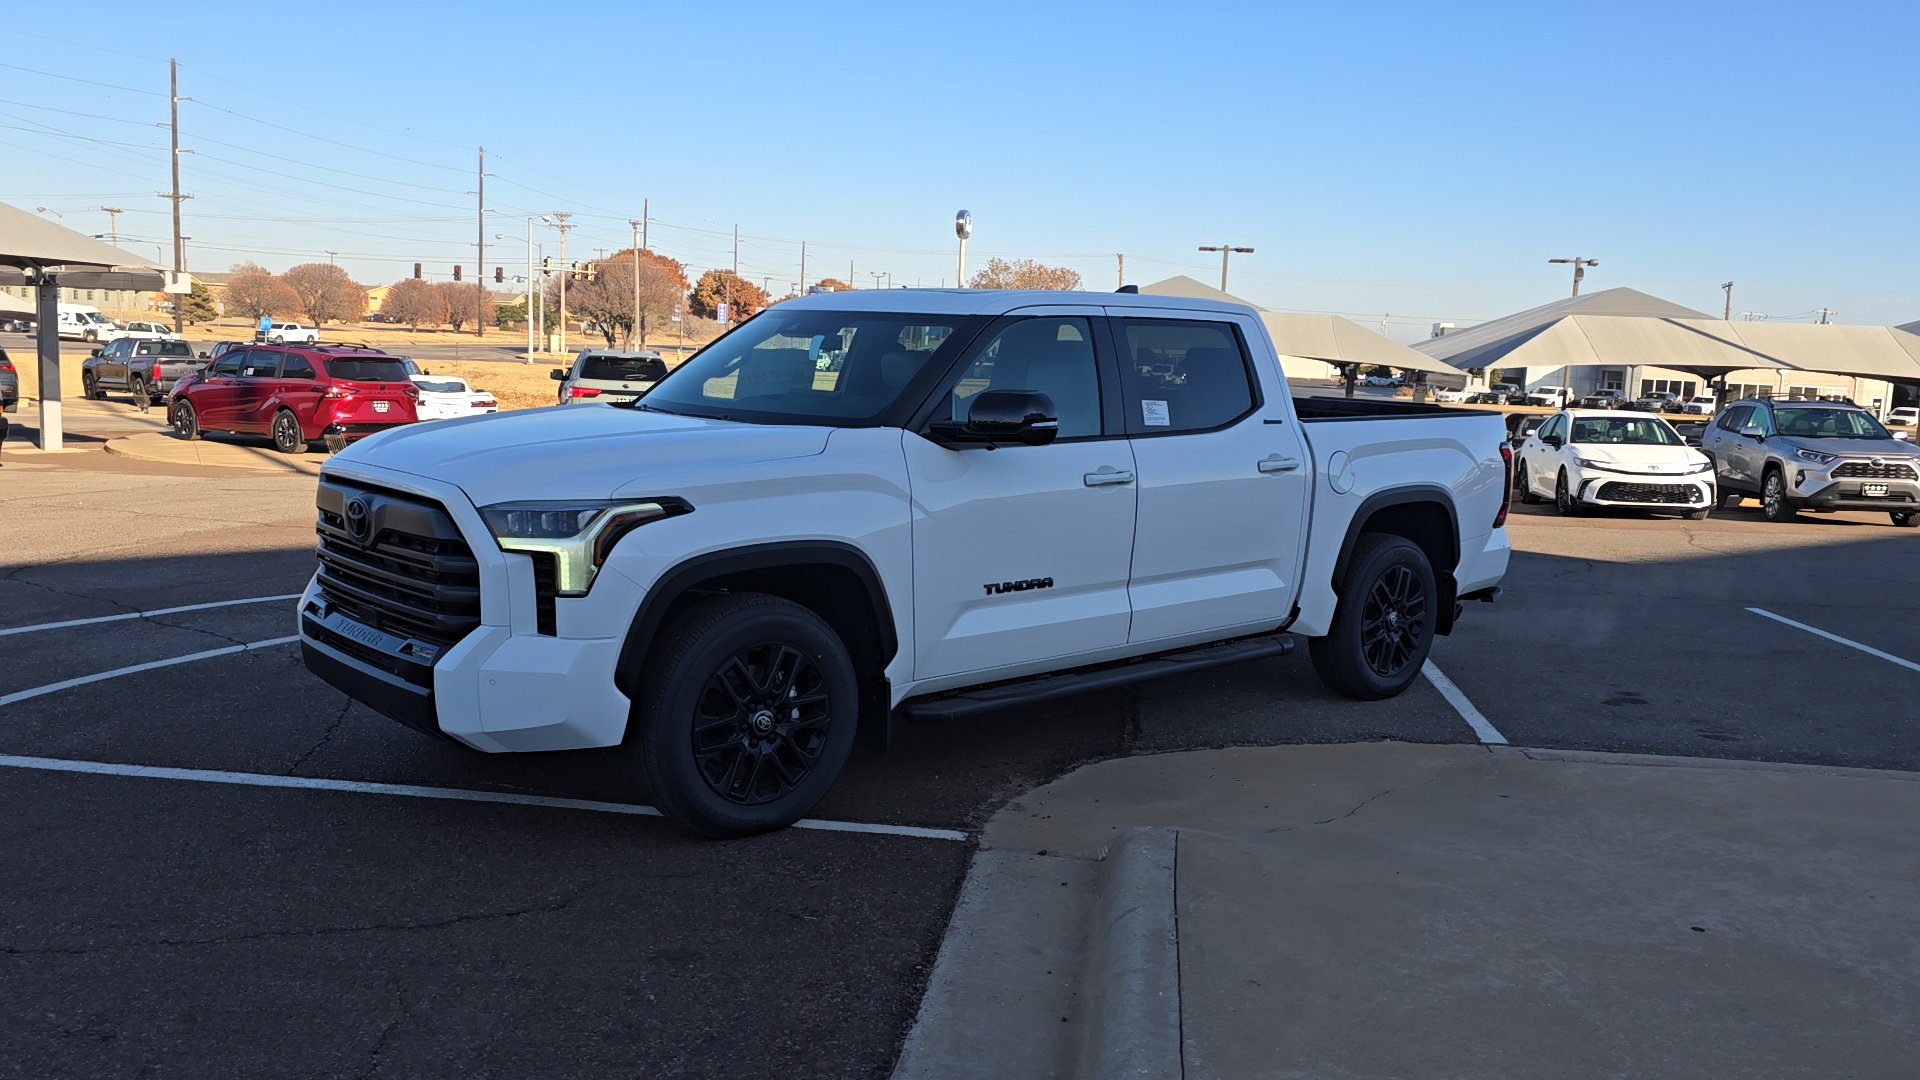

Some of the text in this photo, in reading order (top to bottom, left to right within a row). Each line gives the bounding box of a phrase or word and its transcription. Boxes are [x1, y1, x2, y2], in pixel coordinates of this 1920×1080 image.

[769, 369, 804, 379] TOYOTA
[984, 577, 1054, 595] TUNDRA
[336, 619, 383, 646] TUNDRA
